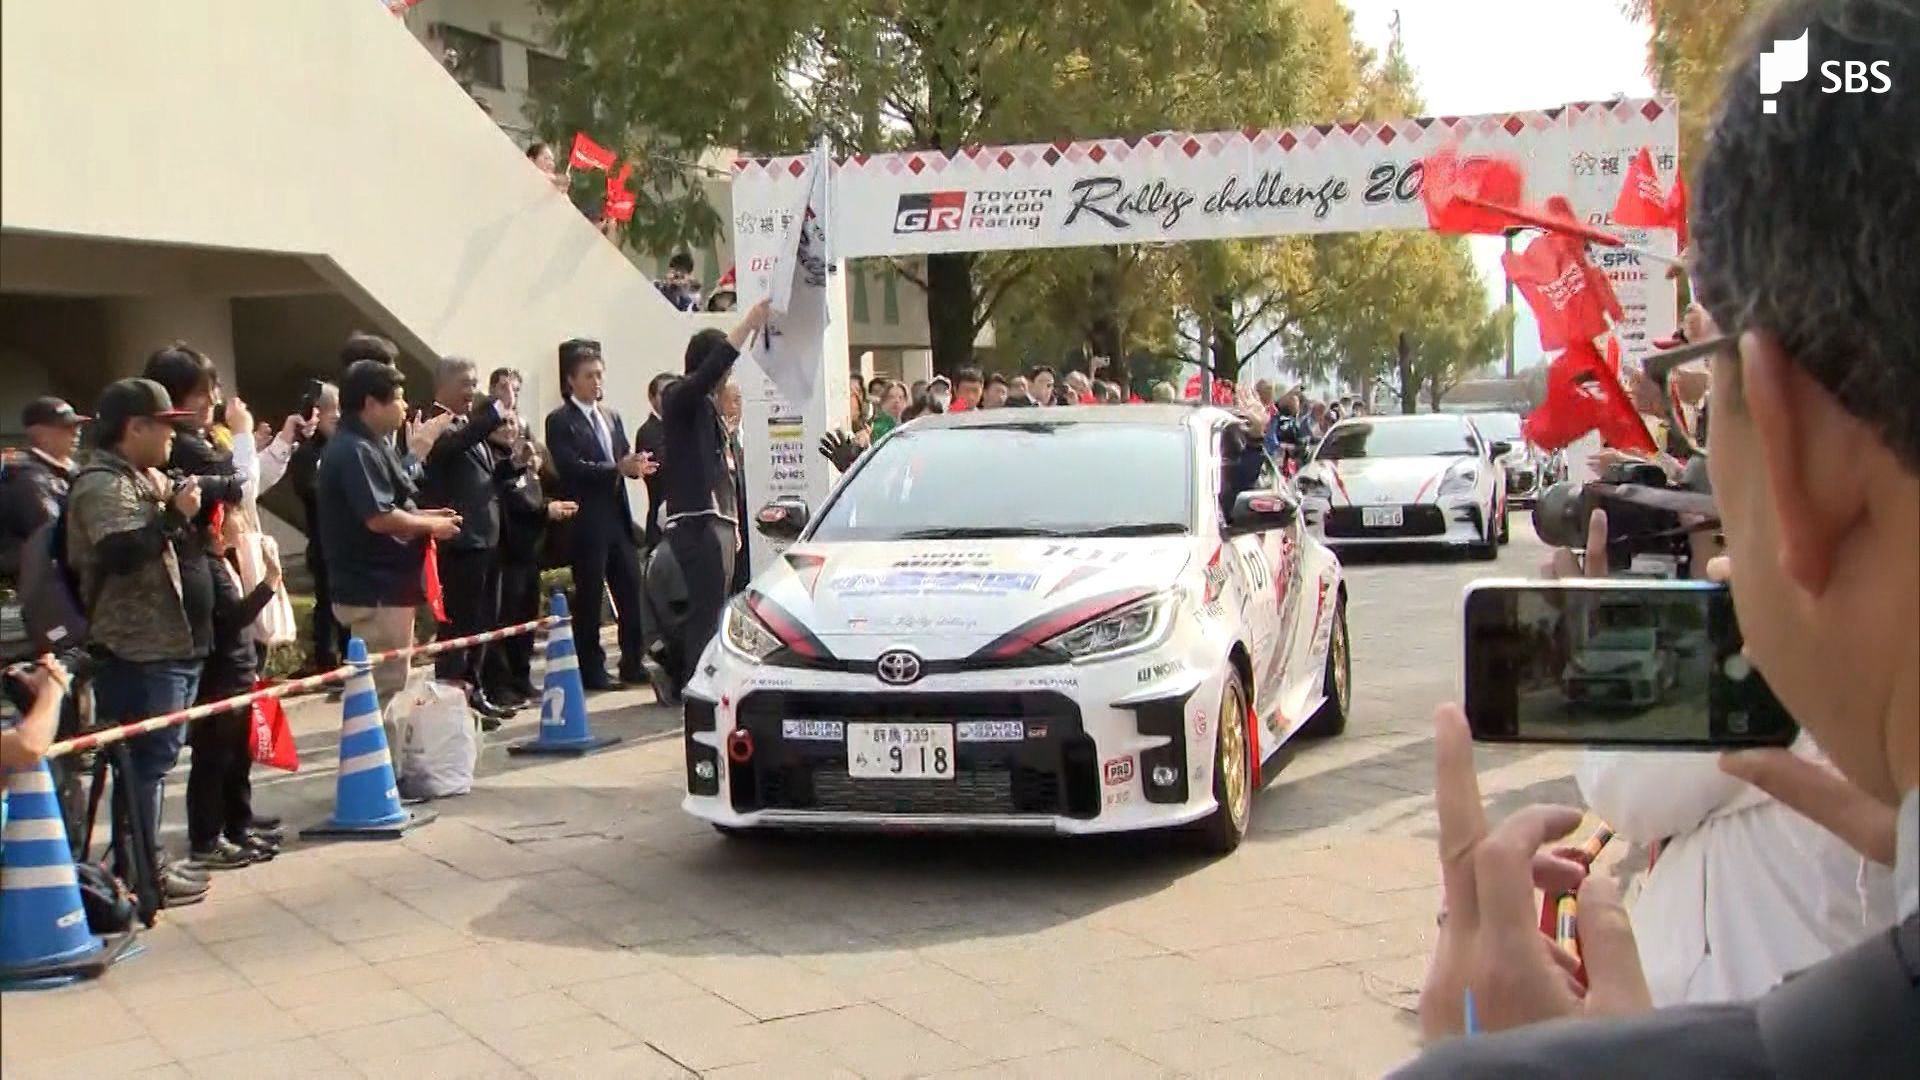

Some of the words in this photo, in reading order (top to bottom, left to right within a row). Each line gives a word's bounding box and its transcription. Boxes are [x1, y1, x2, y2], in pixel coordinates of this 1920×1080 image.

[973, 189, 1053, 202] TOYOTA
[1064, 176, 1195, 230] Rally
[1203, 169, 1348, 219] challenge
[971, 202, 1044, 216] GAZOO
[896, 207, 963, 231] GR
[970, 216, 1041, 230] Racing
[1602, 252, 1641, 267] SPK
